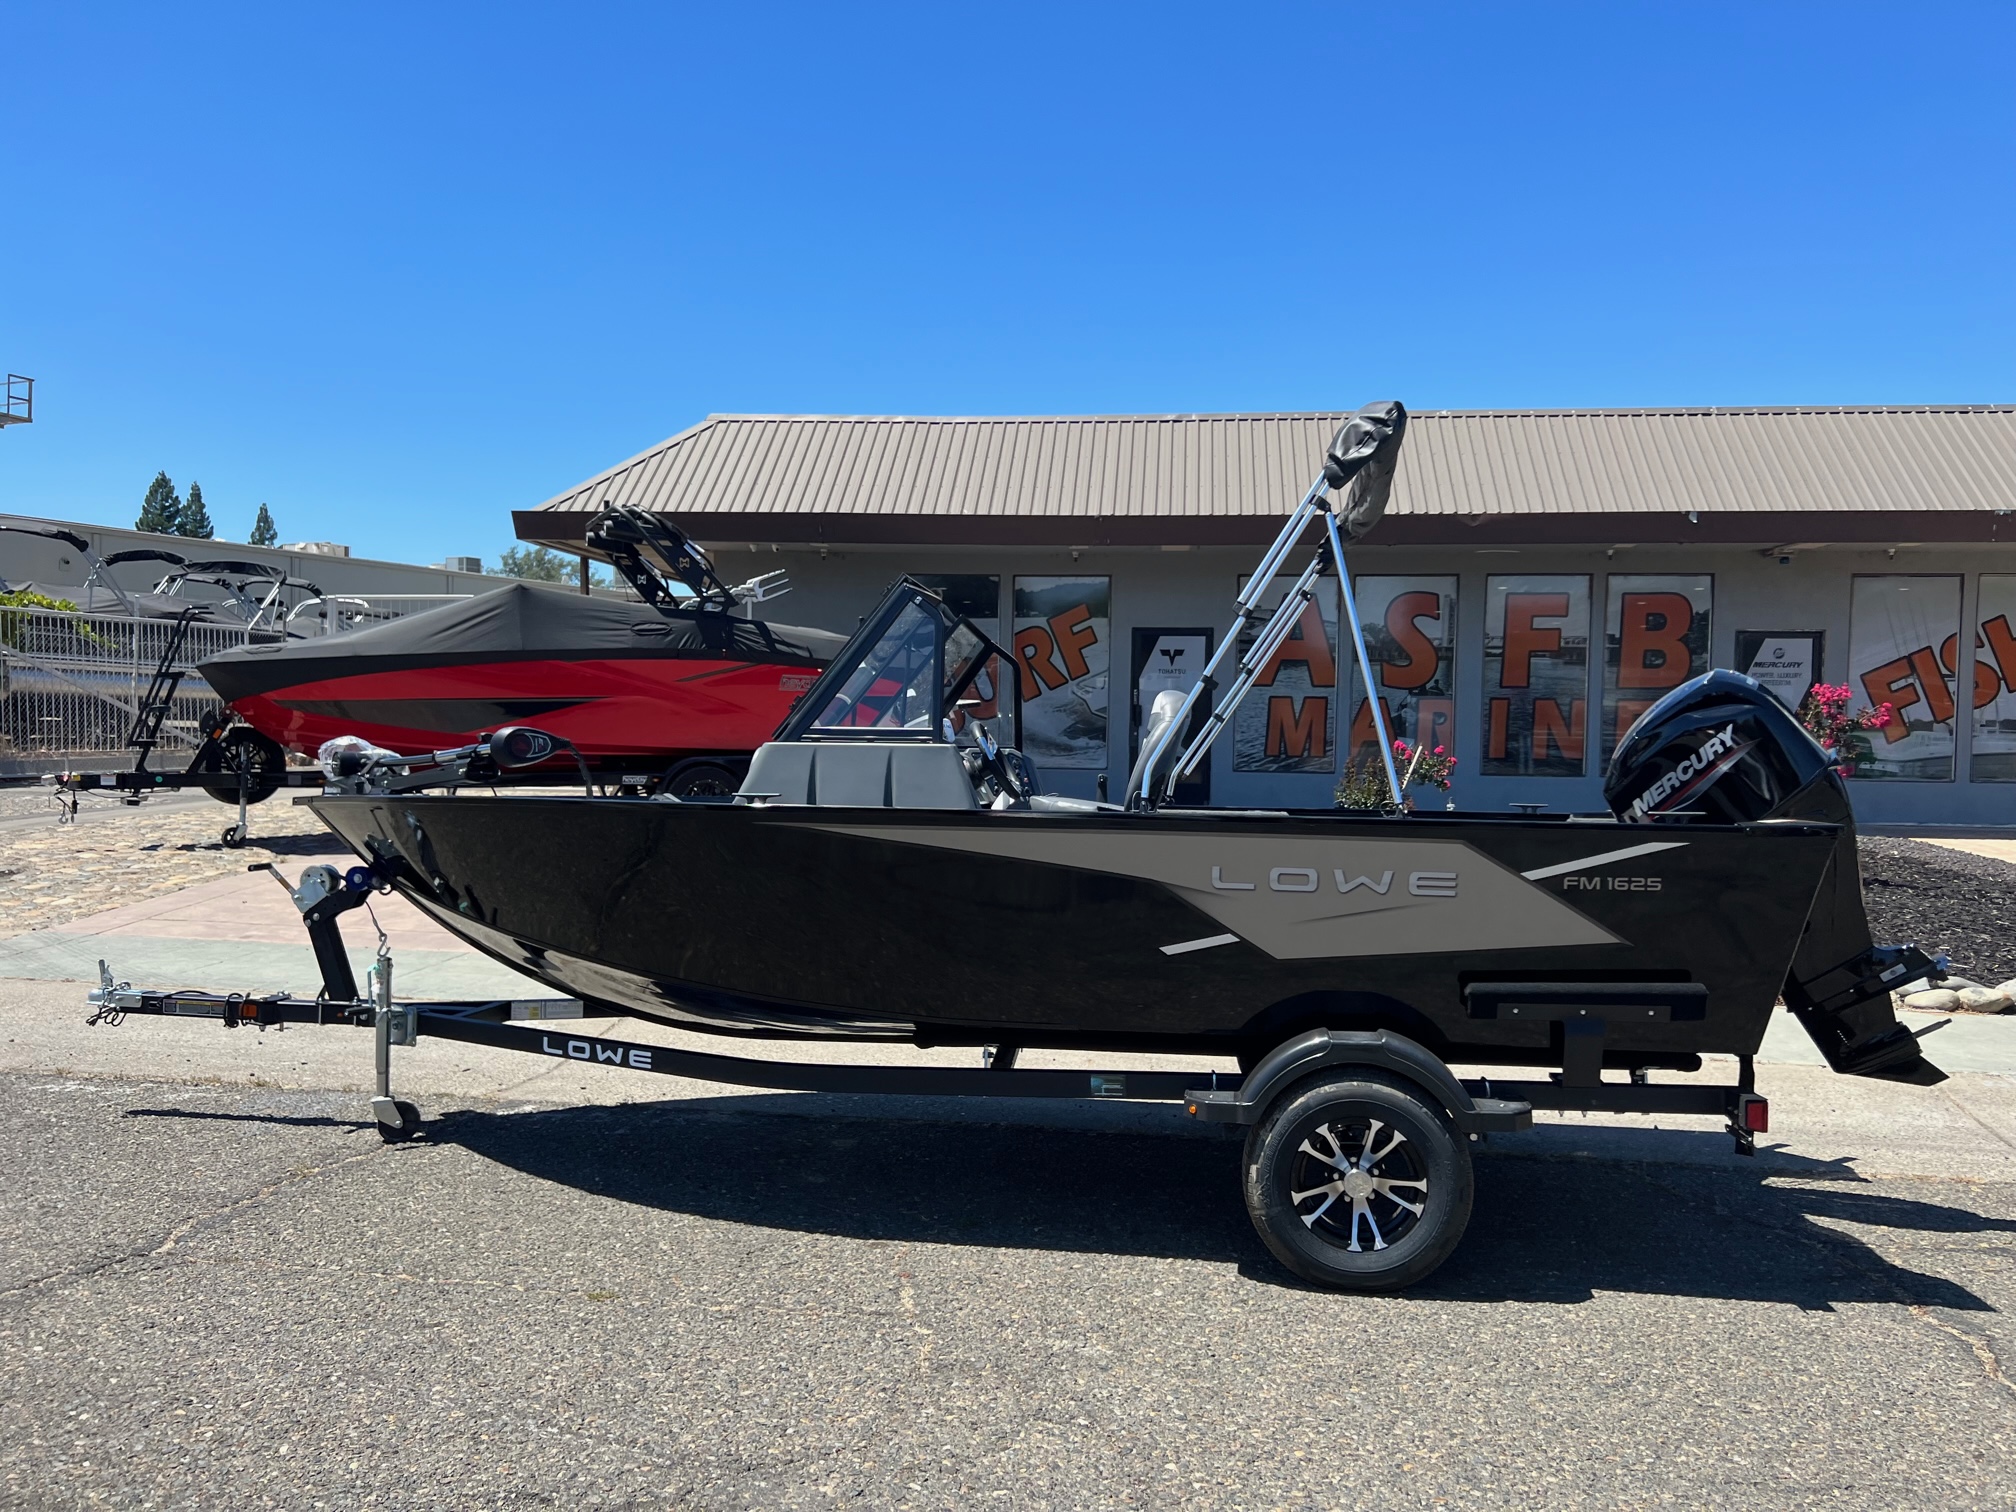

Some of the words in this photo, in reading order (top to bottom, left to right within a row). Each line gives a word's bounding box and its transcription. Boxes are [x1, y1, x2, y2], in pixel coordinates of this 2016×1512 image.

[1632, 723, 1734, 817] MERCURY
[1211, 866, 1457, 896] LOWE
[1563, 877, 1601, 890] FM
[1607, 878, 1662, 891] 1625
[543, 1036, 652, 1069] LOWE
